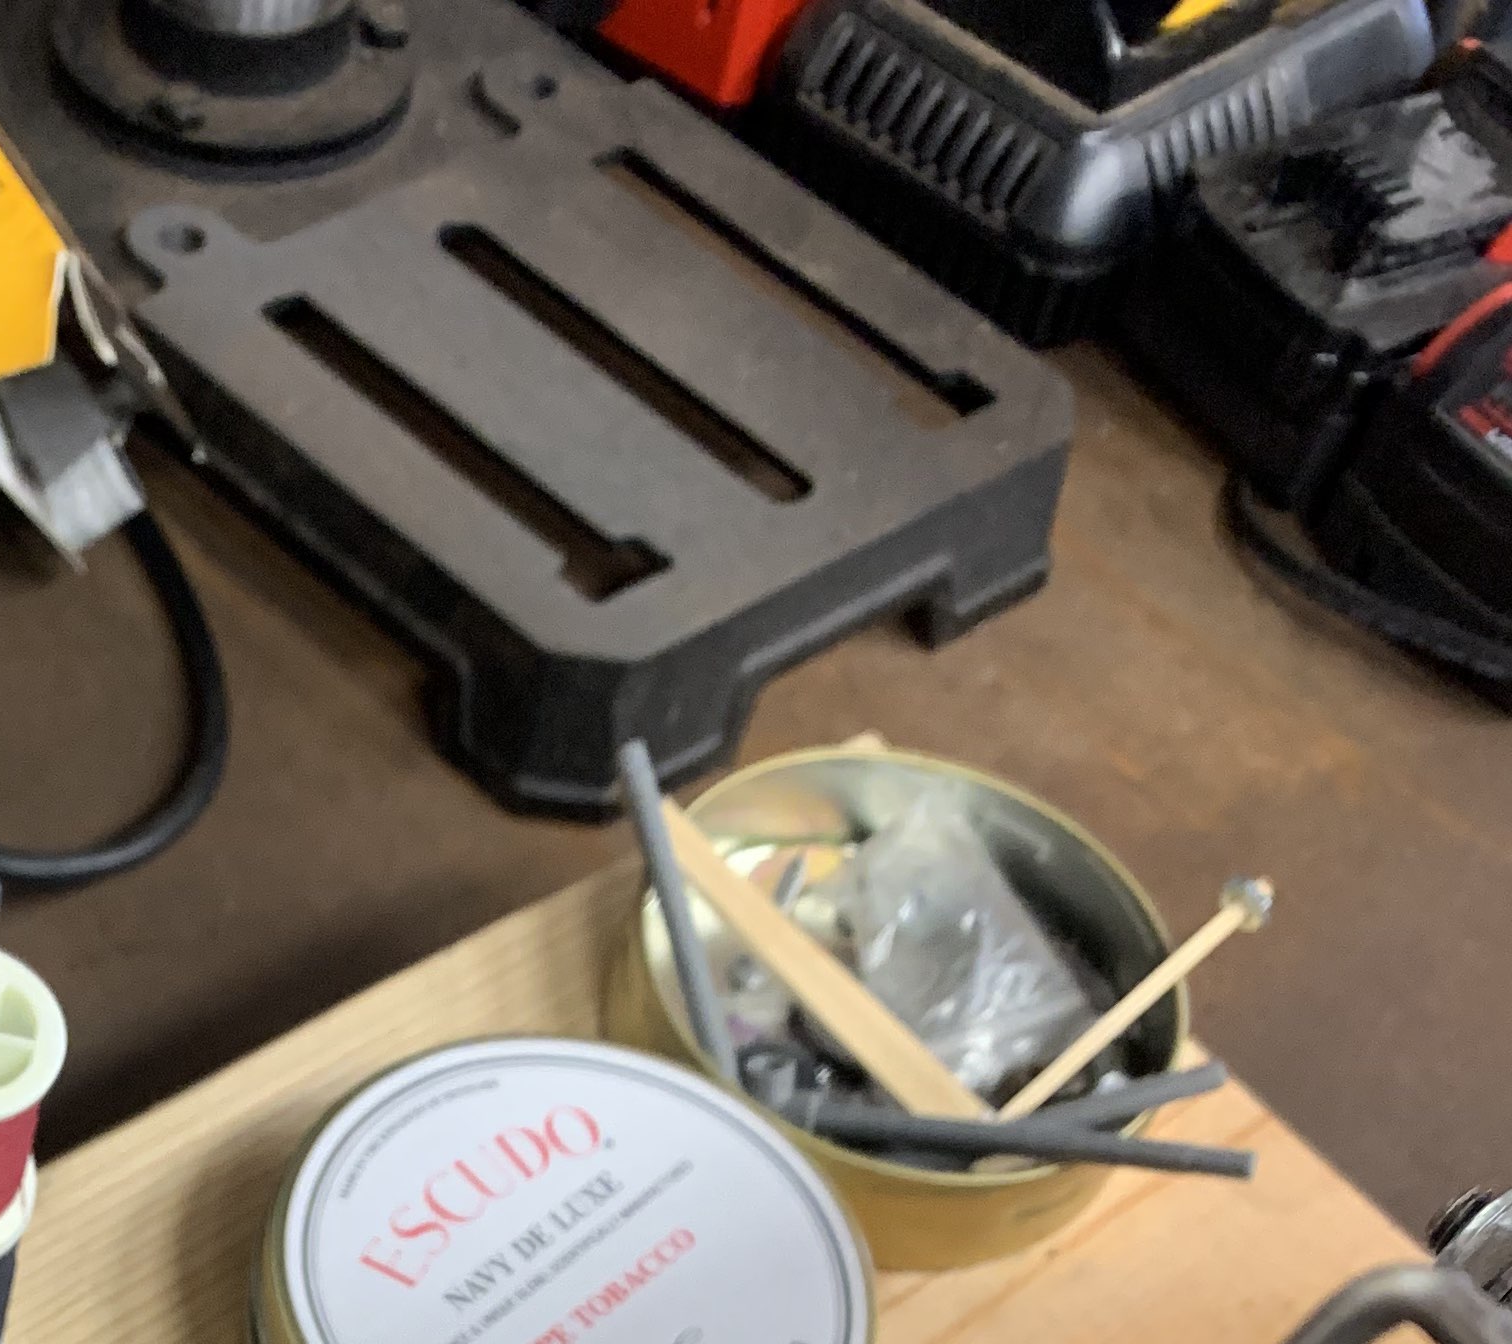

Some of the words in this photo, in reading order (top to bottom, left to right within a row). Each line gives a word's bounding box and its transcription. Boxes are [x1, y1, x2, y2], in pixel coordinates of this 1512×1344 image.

[443, 1251, 515, 1311] NAVY
[510, 1221, 555, 1272] DE
[546, 1170, 624, 1234] LUXE
[568, 1237, 698, 1330] TOBACCO
